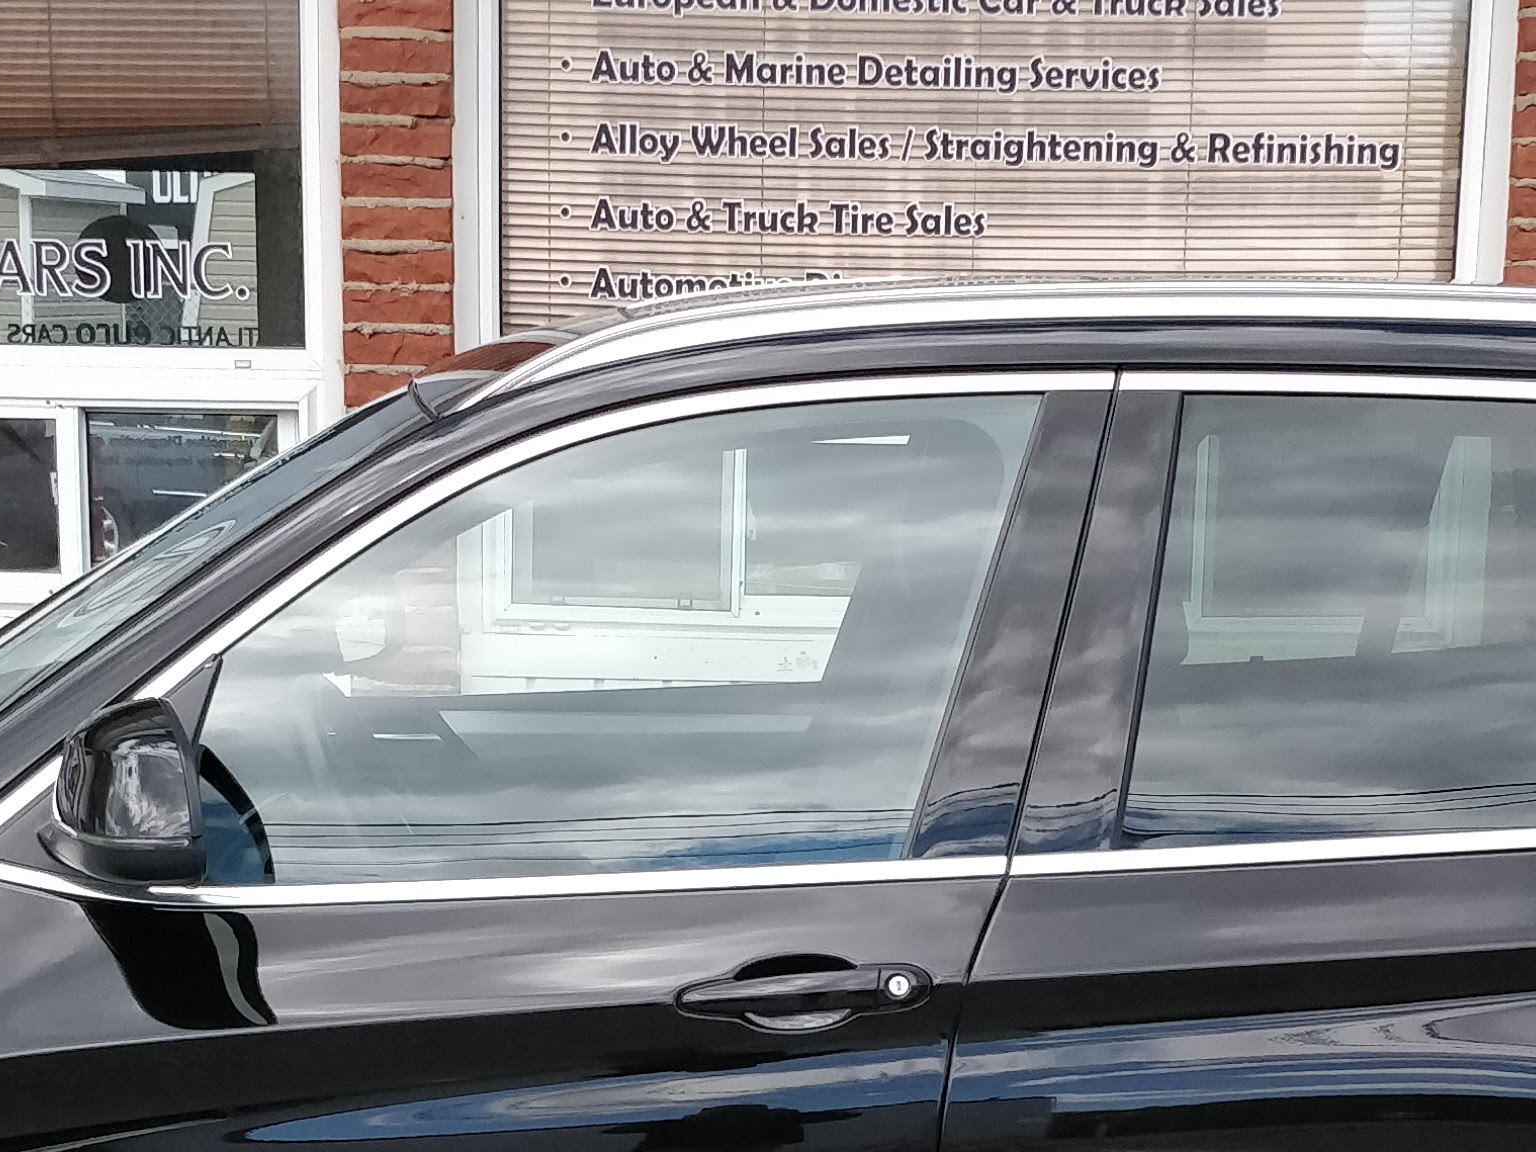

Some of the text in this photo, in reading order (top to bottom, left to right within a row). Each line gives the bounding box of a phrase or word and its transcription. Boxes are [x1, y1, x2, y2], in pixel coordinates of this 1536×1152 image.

[591, 49, 1163, 93] Auto & Marine Detailing Services
[590, 122, 1401, 170] Alloy Wheel Sales / Straightening & Refinishing
[590, 198, 987, 237] Auto & Truck Tire Sales
[125, 238, 251, 300] INC.
